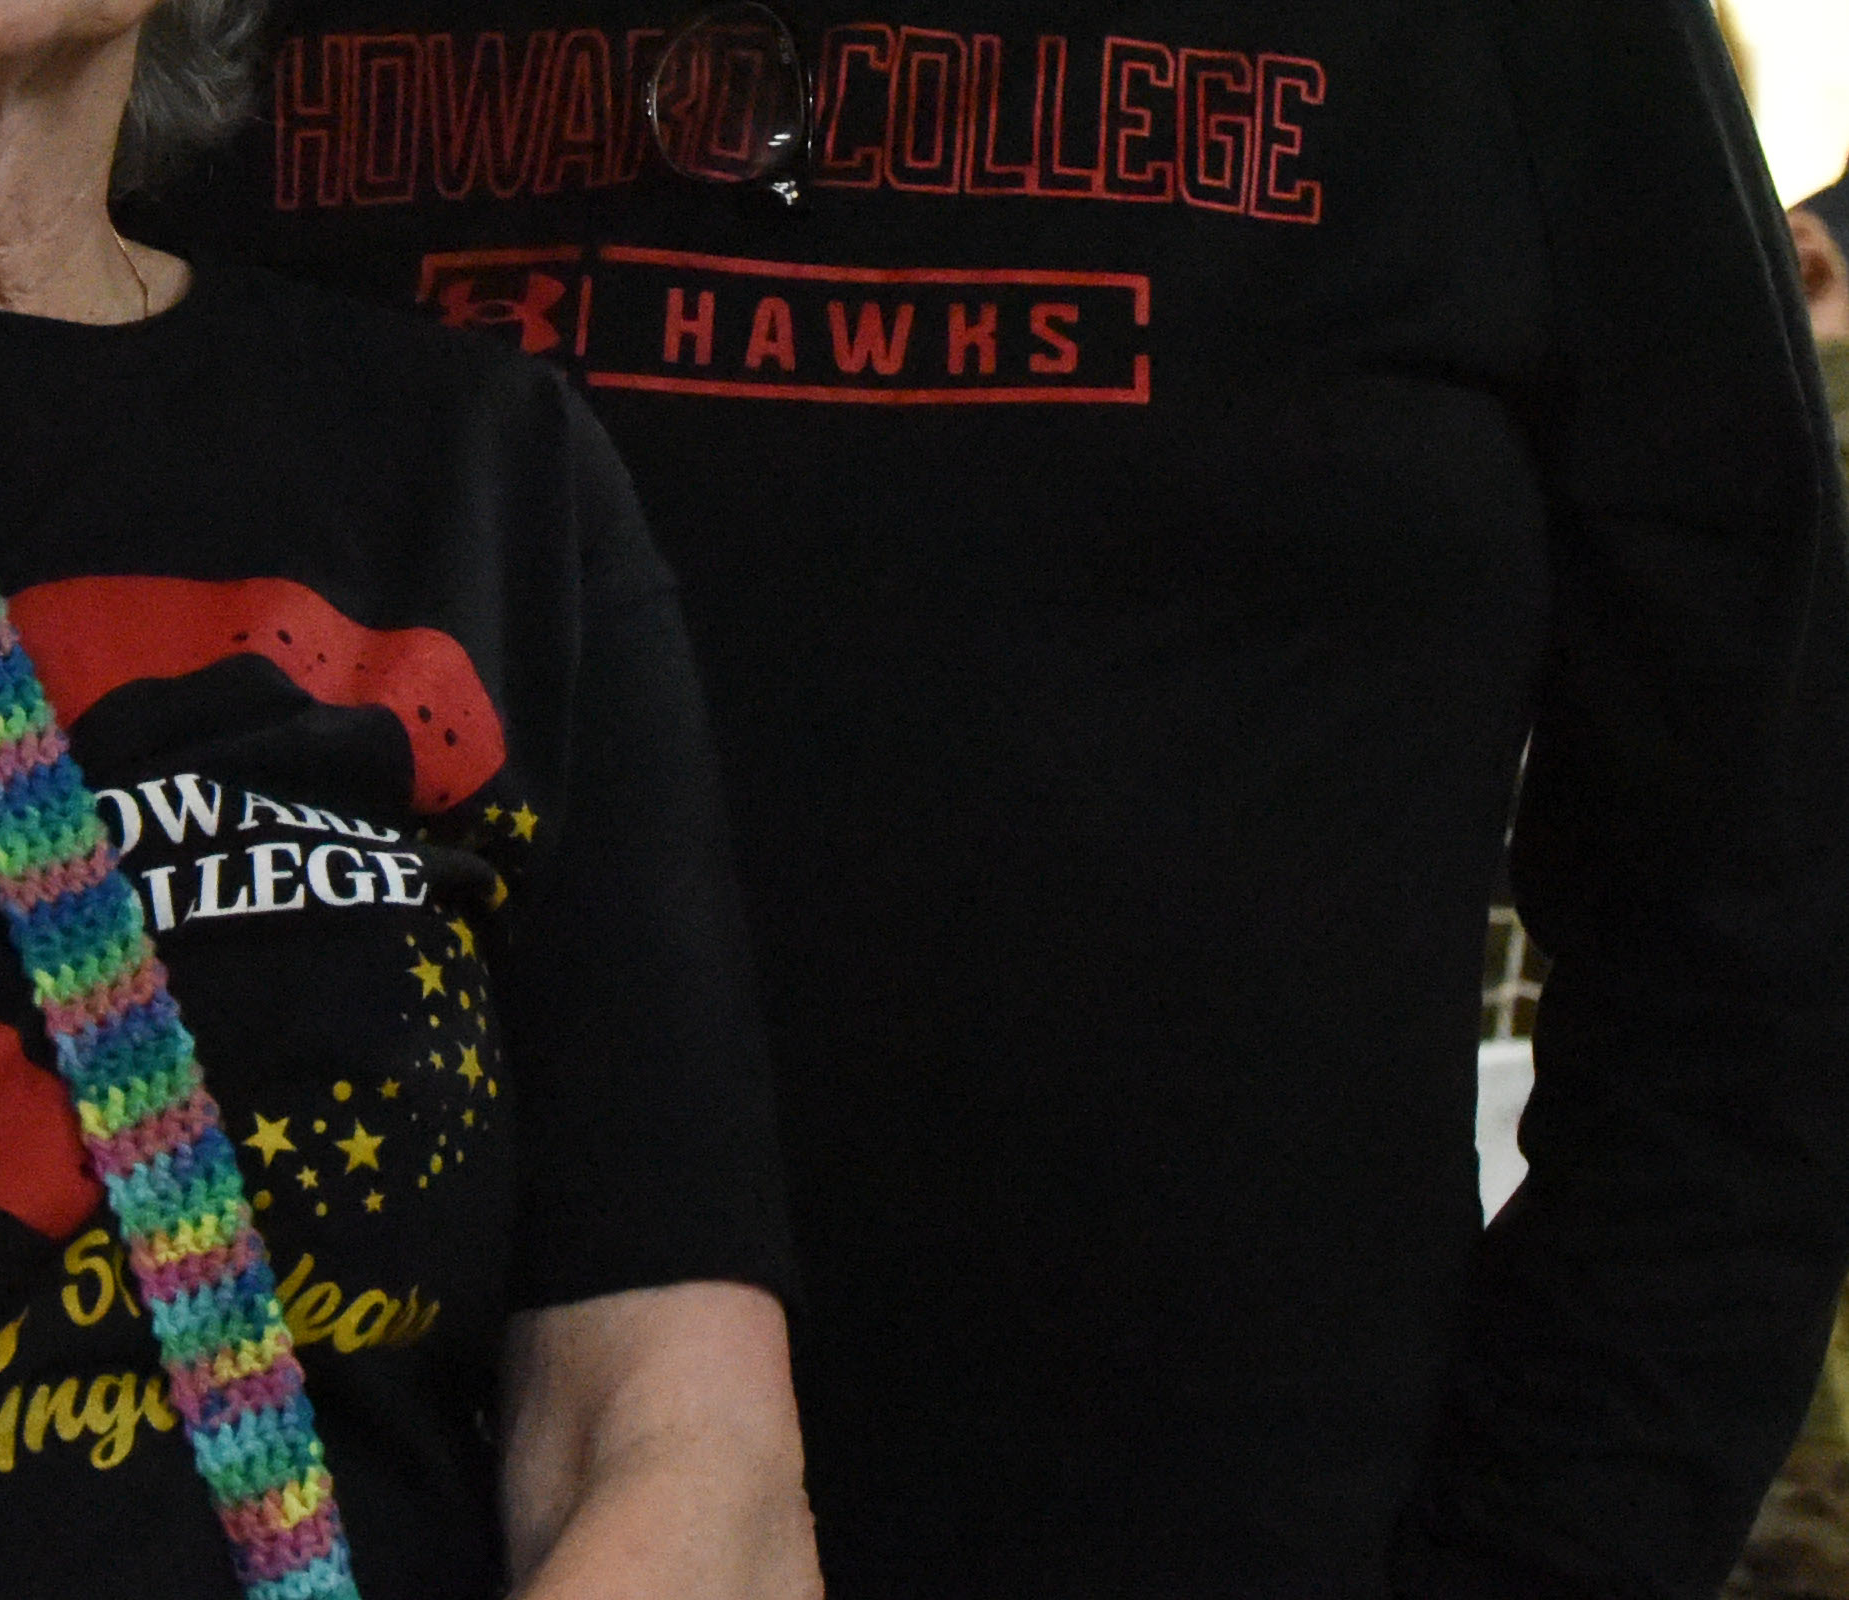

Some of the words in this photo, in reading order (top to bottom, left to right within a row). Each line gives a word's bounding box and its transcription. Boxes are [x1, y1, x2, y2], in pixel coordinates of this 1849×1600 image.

[274, 20, 782, 212] HOWARD
[812, 21, 1328, 225] COLLEGE
[663, 286, 1080, 375] HAWKS
[141, 842, 428, 931] LLEGE
